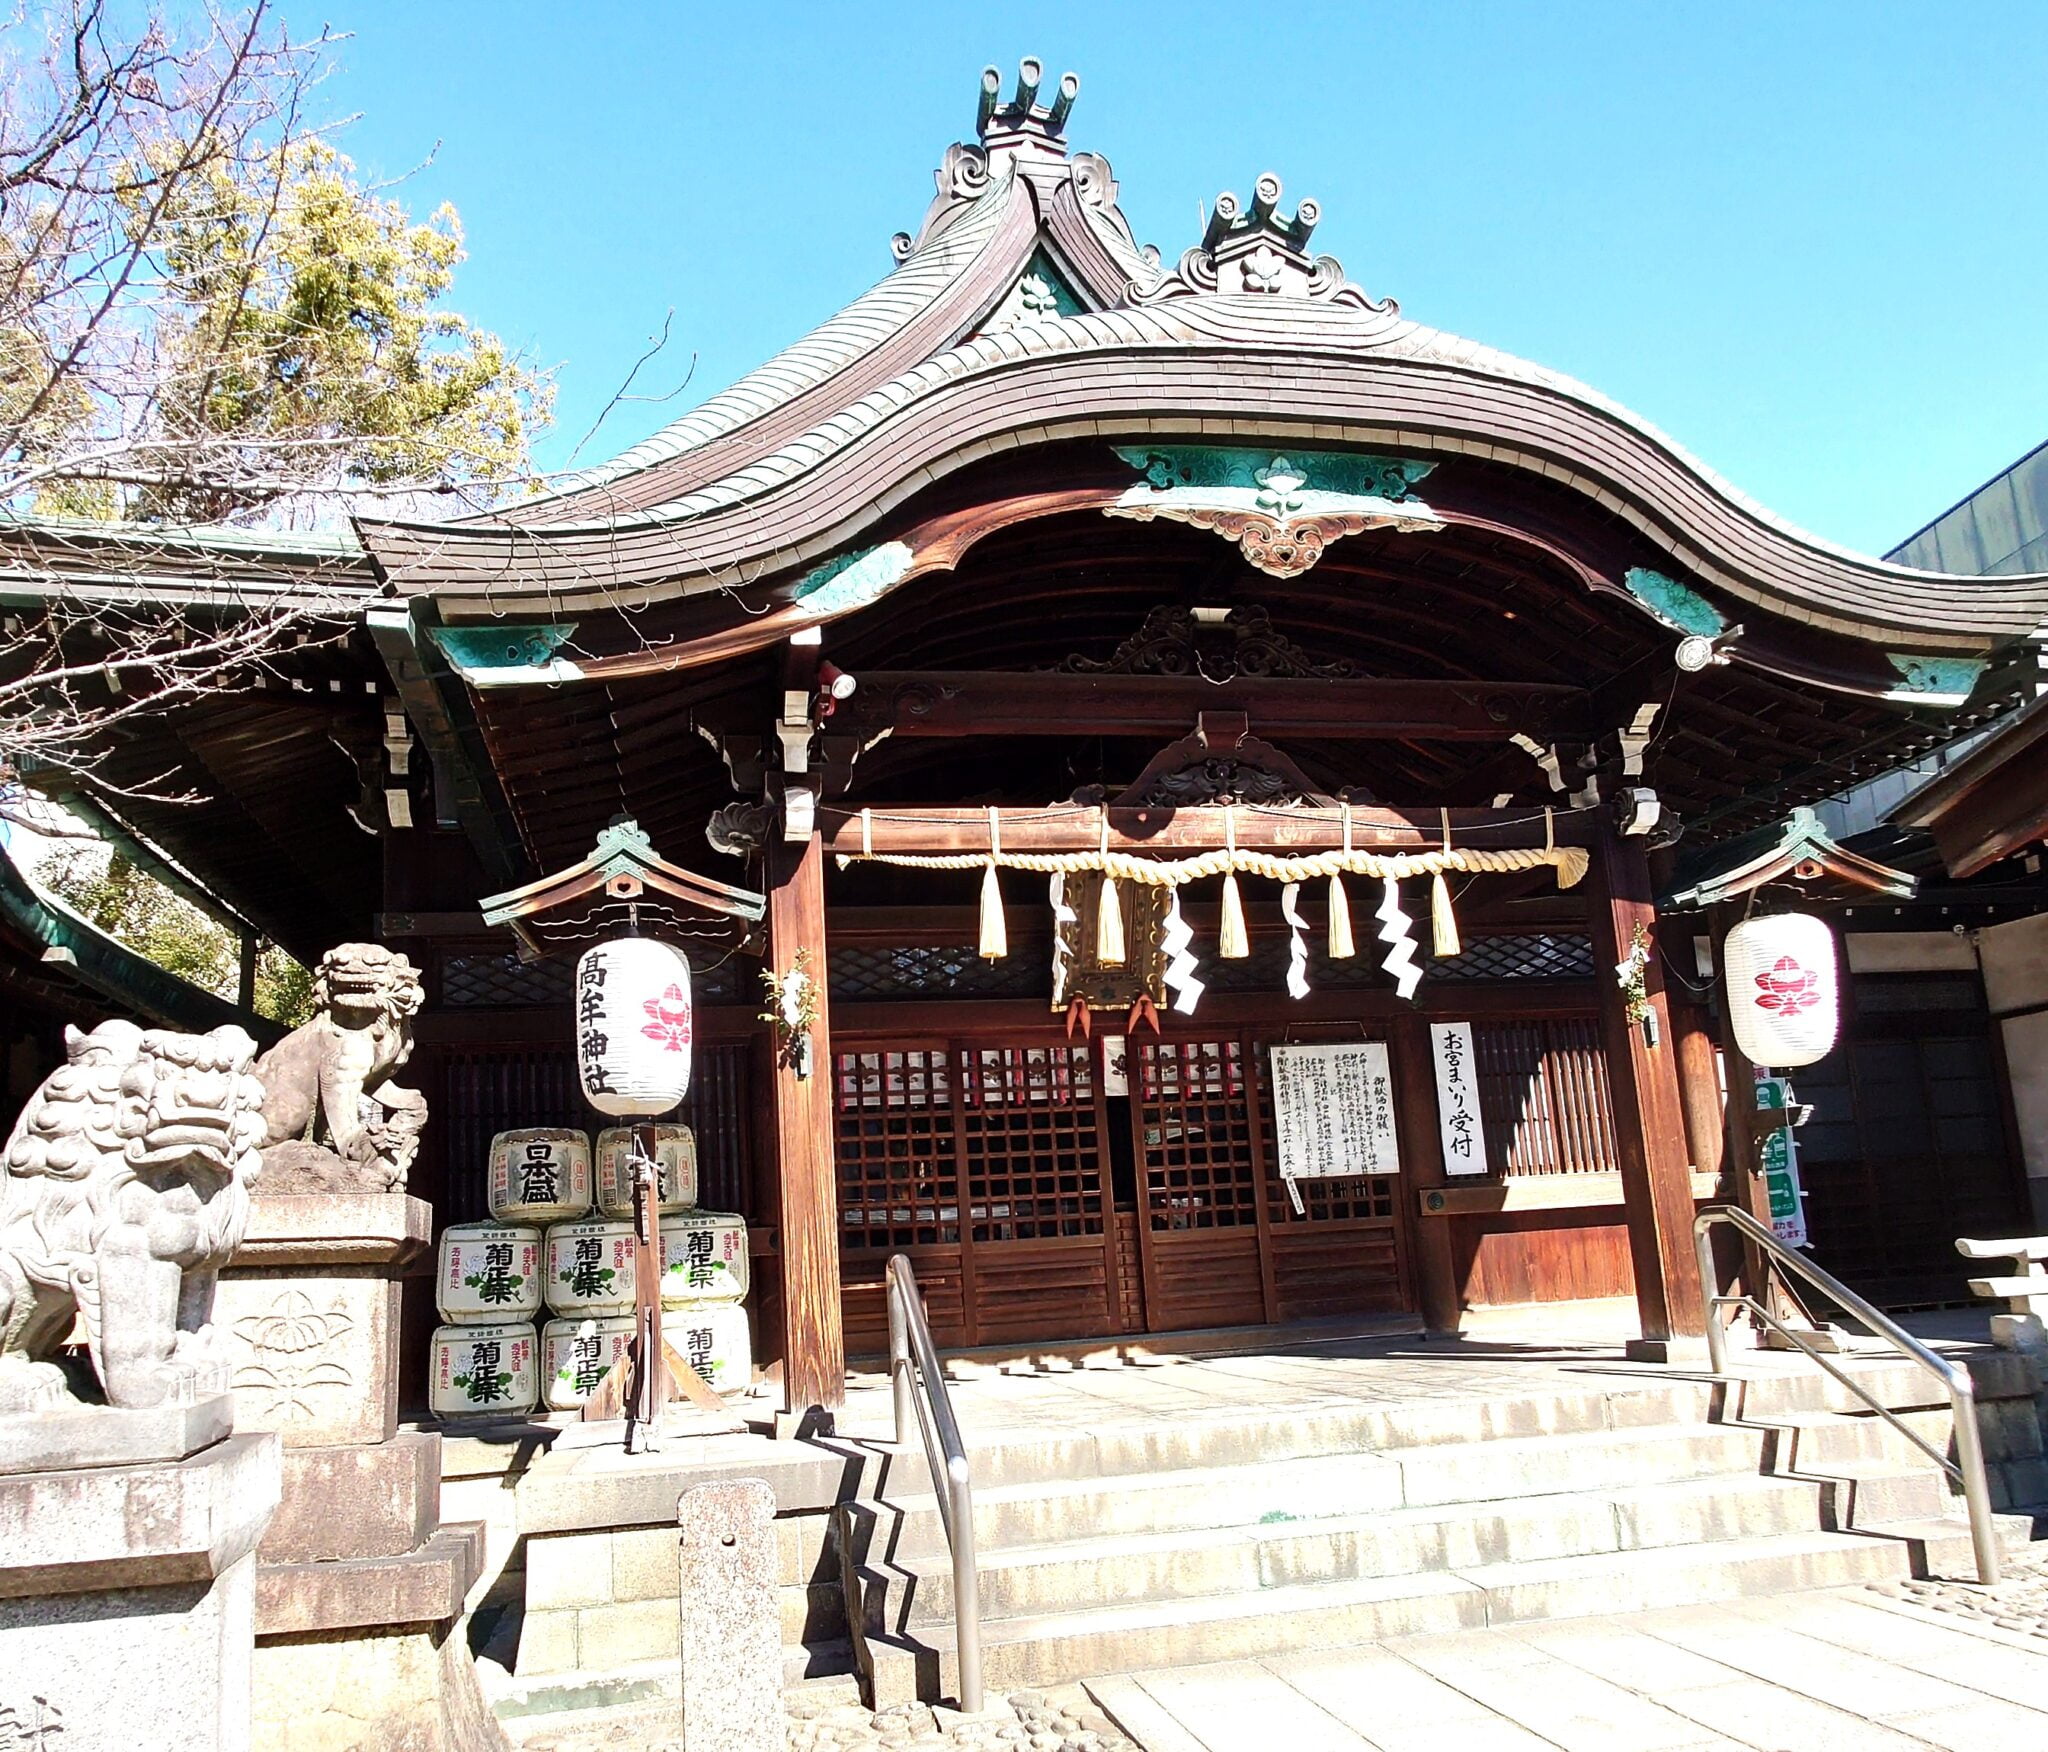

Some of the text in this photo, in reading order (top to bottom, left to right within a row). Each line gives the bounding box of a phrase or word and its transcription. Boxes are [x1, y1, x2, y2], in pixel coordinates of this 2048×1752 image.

[1443, 1030, 1474, 1158] お宮まいり受付
[520, 1144, 559, 1205] 日本盛
[484, 1243, 514, 1305] 菊正宗
[574, 1237, 603, 1299] 菊正宗
[686, 1230, 715, 1289] 菊正宗
[471, 1341, 502, 1404] 菊正宗
[573, 1335, 602, 1397] 菊正宗
[686, 1327, 715, 1386] 菊正宗
